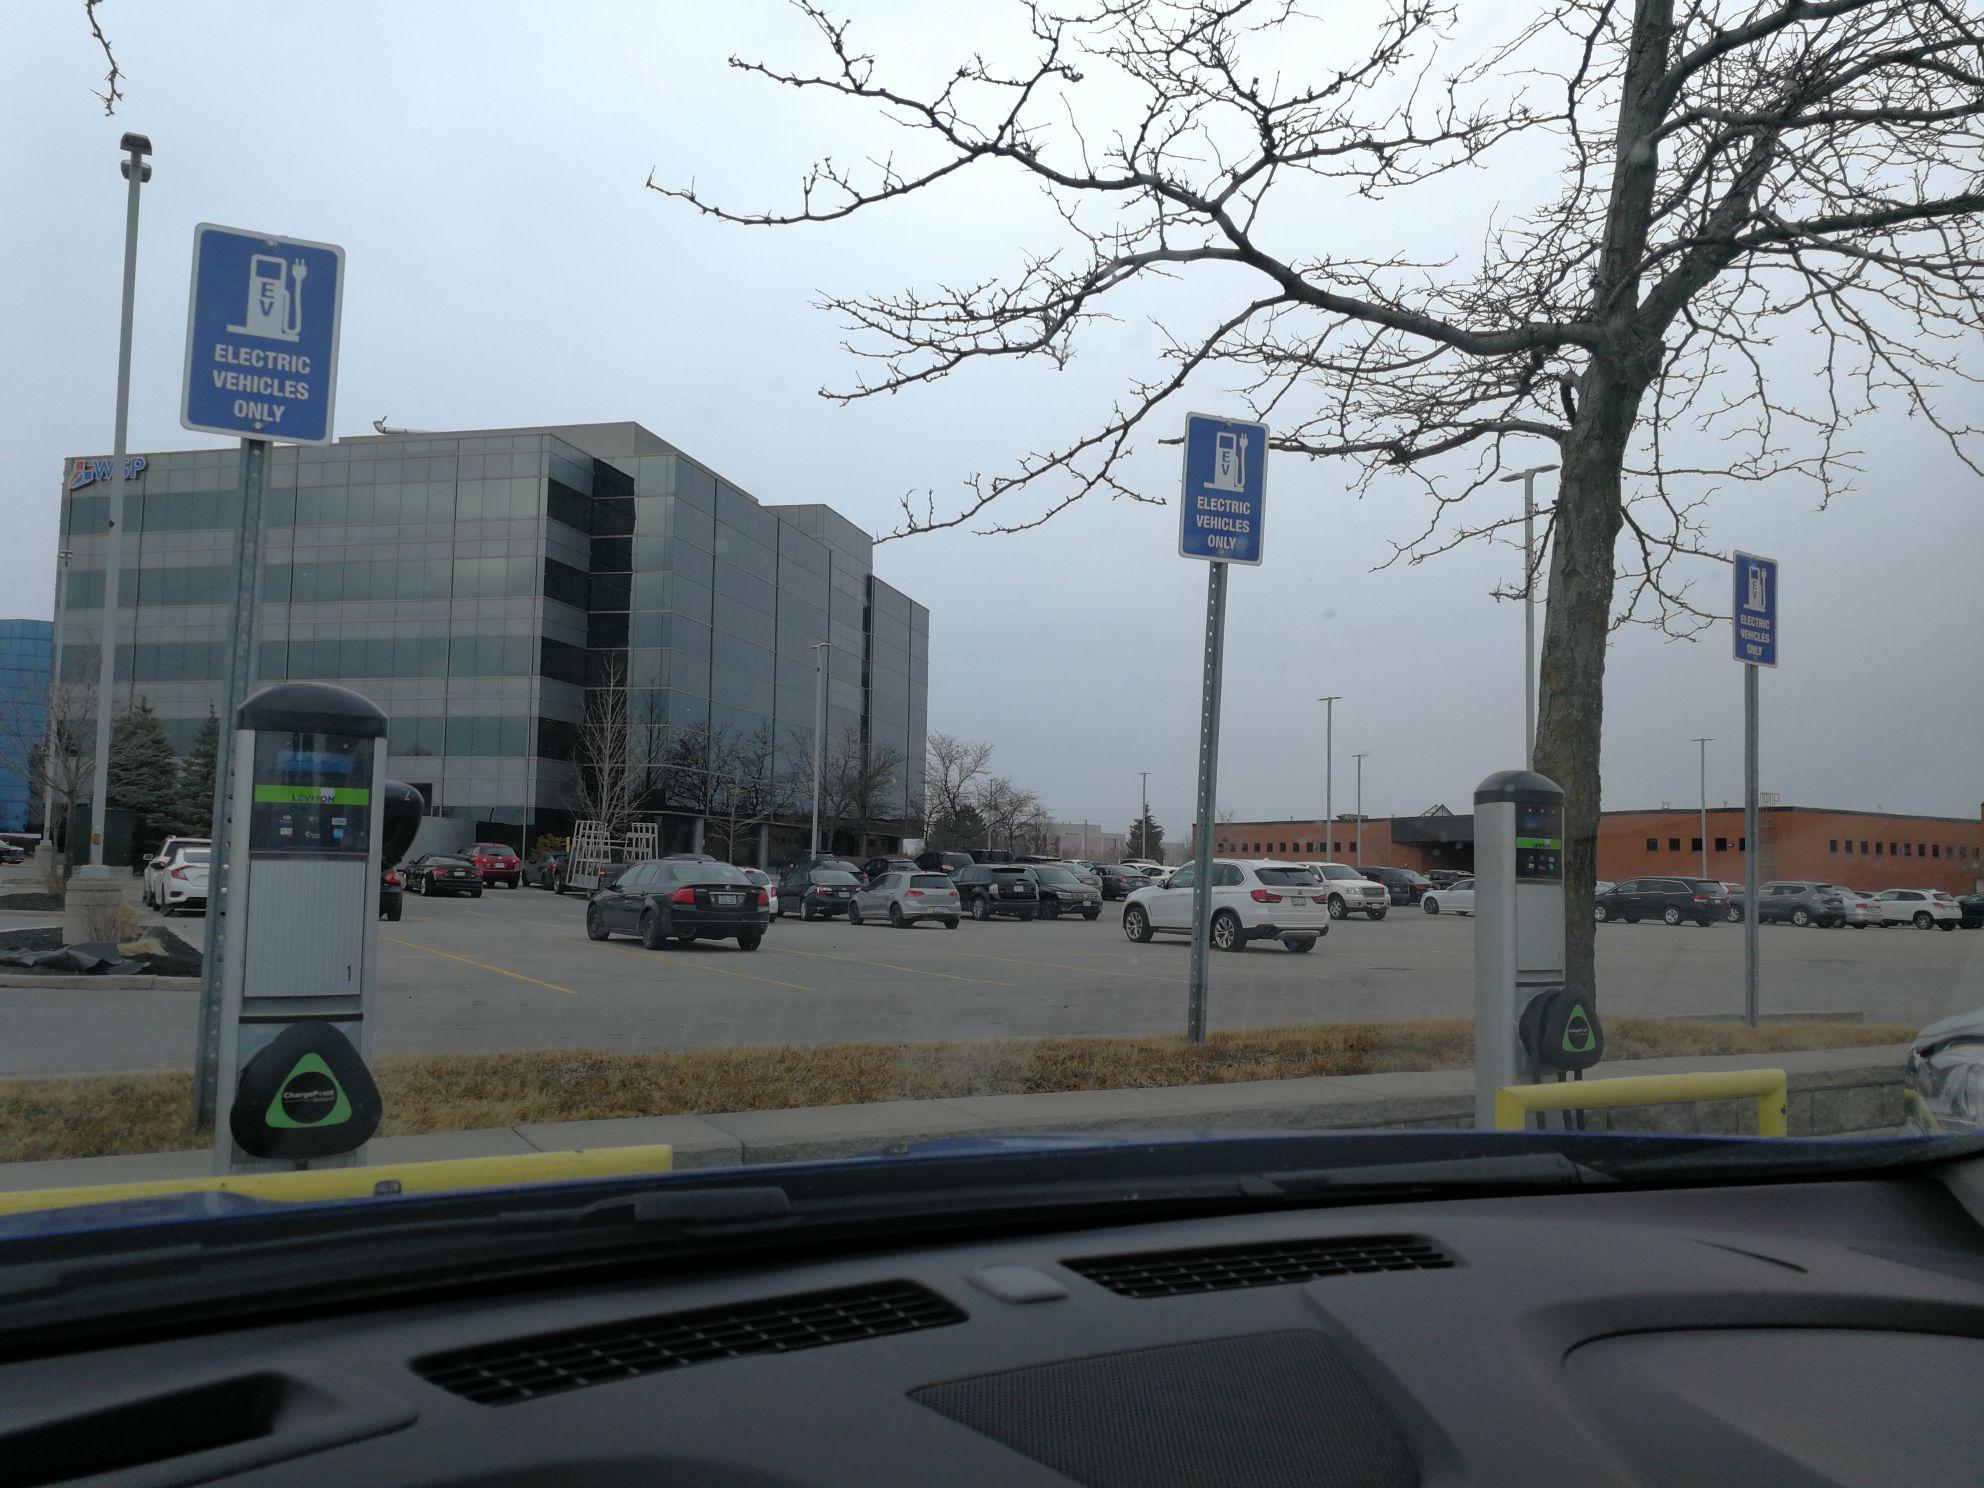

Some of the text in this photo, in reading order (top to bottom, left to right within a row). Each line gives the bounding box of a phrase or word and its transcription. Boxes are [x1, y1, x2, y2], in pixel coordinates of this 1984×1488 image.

[214, 343, 312, 375] ELECTRIC
[212, 369, 310, 400] VEHICLES
[233, 399, 286, 423] ONLY
[1197, 496, 1251, 515] ELECTRIC
[1196, 514, 1250, 533] VEHICLES
[1207, 534, 1237, 550] ONLY
[1740, 614, 1770, 631] ELECTRIC
[1740, 628, 1770, 644] VEHICLES
[291, 793, 335, 804] LEVITON
[403, 790, 411, 801] 2
[346, 965, 352, 982] 1
[283, 1089, 335, 1100] ChargePoint
